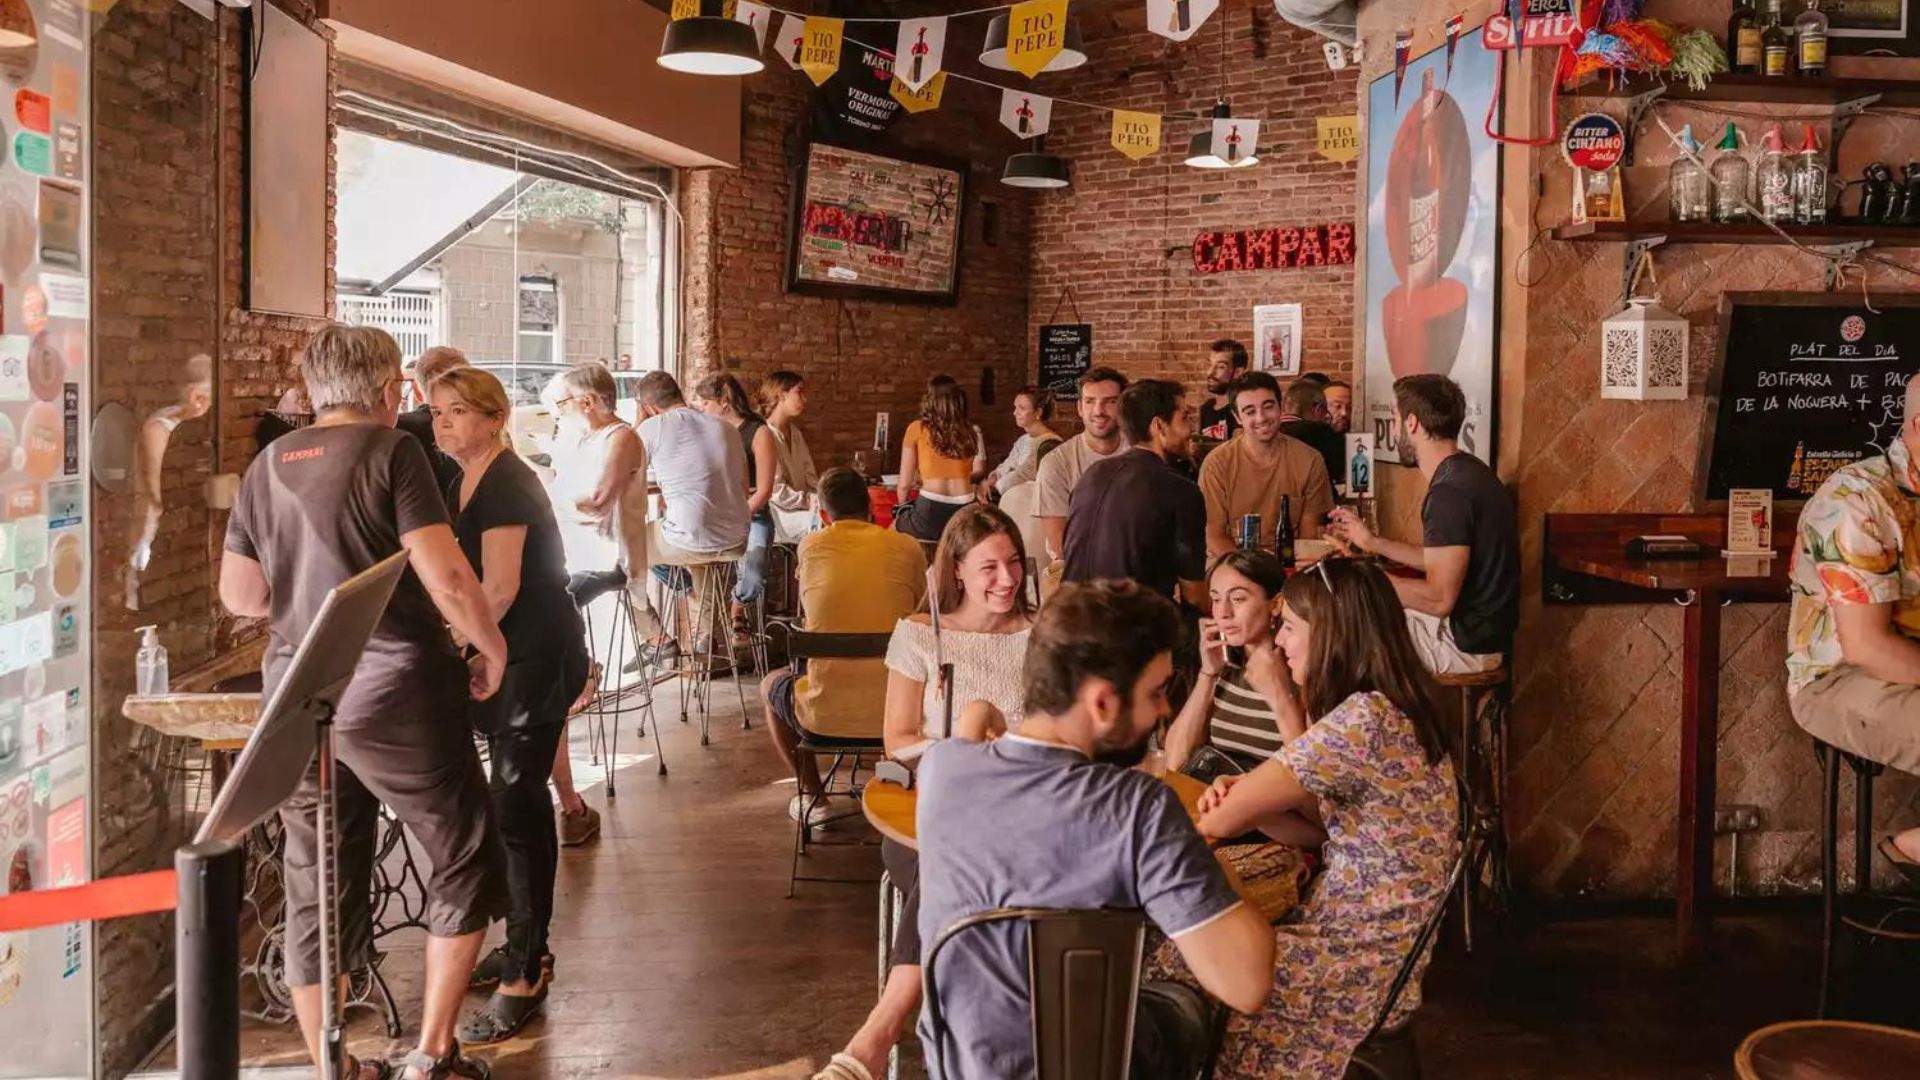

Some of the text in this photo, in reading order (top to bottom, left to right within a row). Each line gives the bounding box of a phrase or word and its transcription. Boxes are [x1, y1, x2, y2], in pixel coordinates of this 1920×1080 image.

[1022, 14, 1054, 35] TIO
[812, 31, 833, 48] TIO
[1014, 30, 1057, 54] PEPE
[805, 46, 836, 65] PEPE
[897, 83, 934, 103] PEPE
[1123, 121, 1149, 135] TIO
[1327, 126, 1353, 140] TIO
[1574, 127, 1610, 137] BITTER
[1117, 132, 1153, 148] PEPE
[1323, 136, 1359, 150] PEPE
[1567, 136, 1621, 150] CINZANO
[1590, 150, 1616, 161] soda
[1192, 222, 1353, 273] CAMPAR
[1839, 344, 1861, 356] DEL
[1850, 374, 1869, 389] DE
[1736, 397, 1756, 413] DE
[1763, 396, 1779, 411] LA
[1787, 394, 1850, 410] NOGUERA
[1352, 462, 1368, 485] 12
